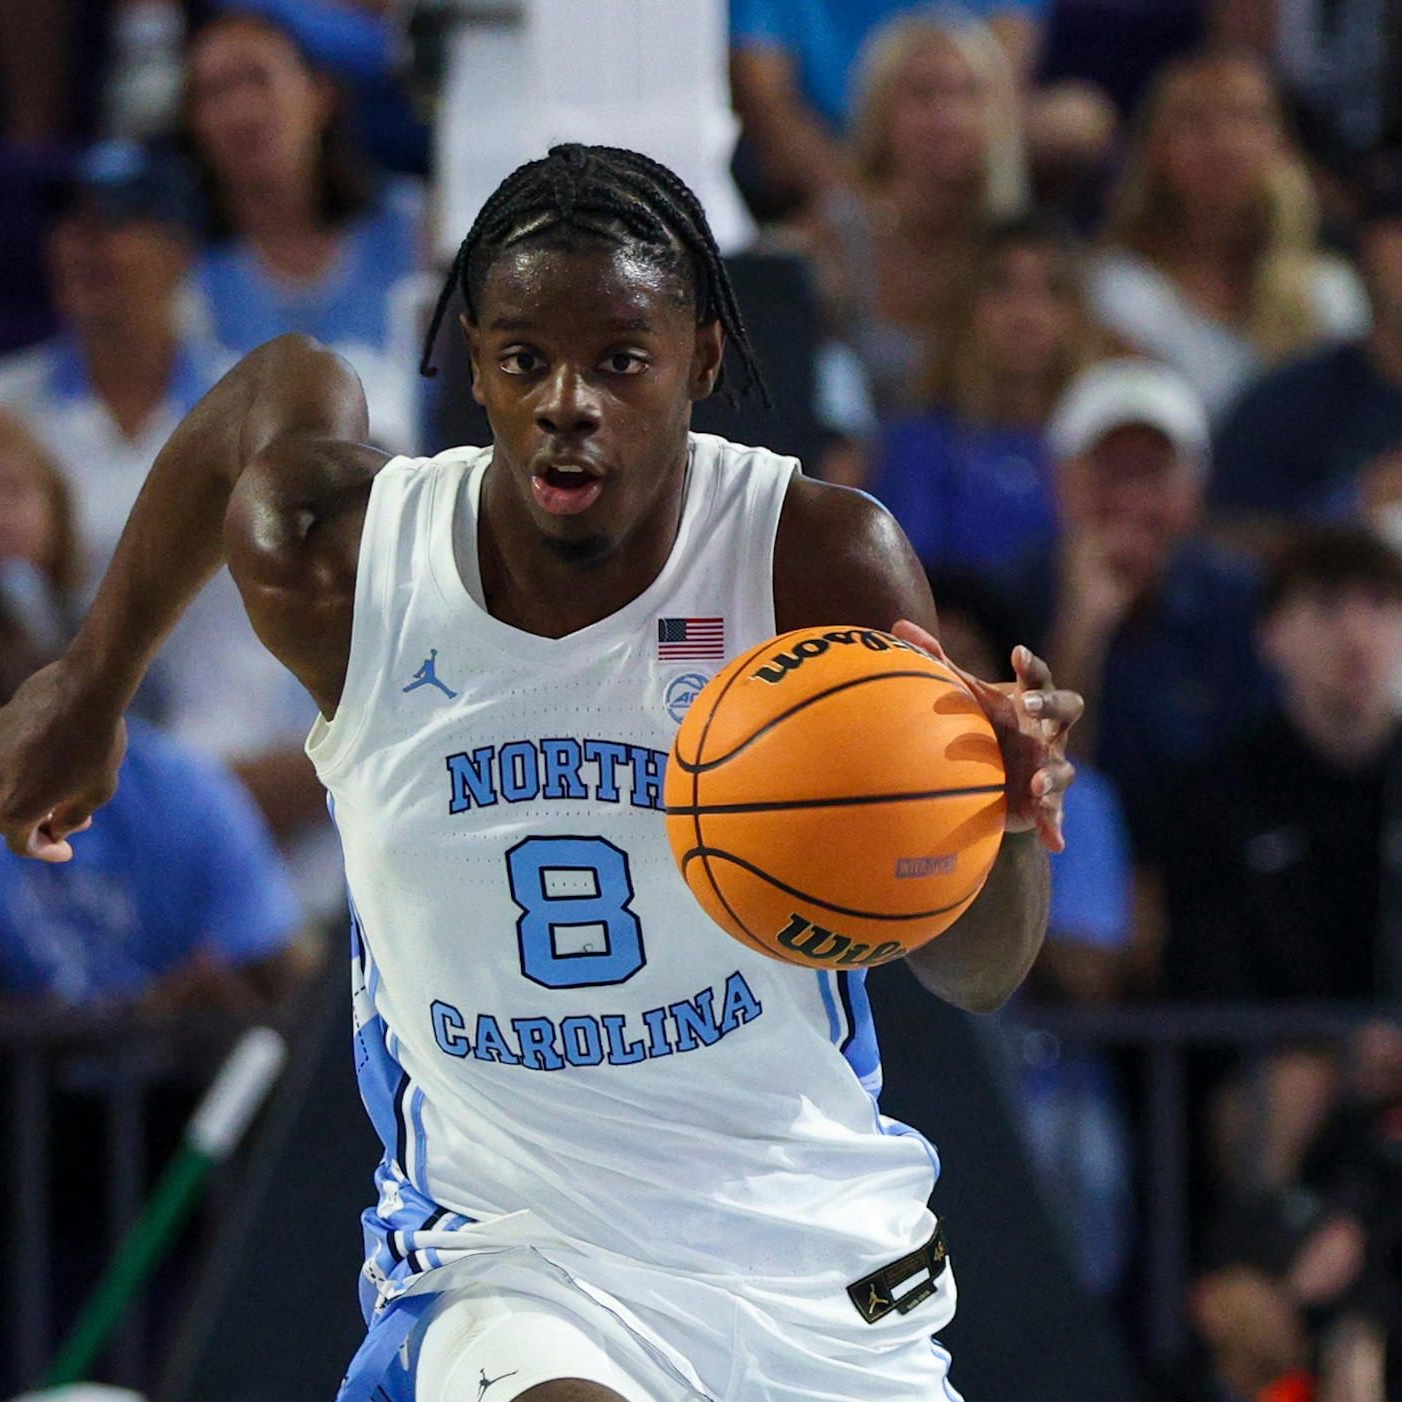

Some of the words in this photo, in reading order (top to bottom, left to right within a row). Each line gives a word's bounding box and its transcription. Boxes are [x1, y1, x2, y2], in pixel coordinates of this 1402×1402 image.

[446, 737, 670, 815] NORTH
[504, 834, 648, 990] 8
[429, 970, 764, 1072] CAROLINA
